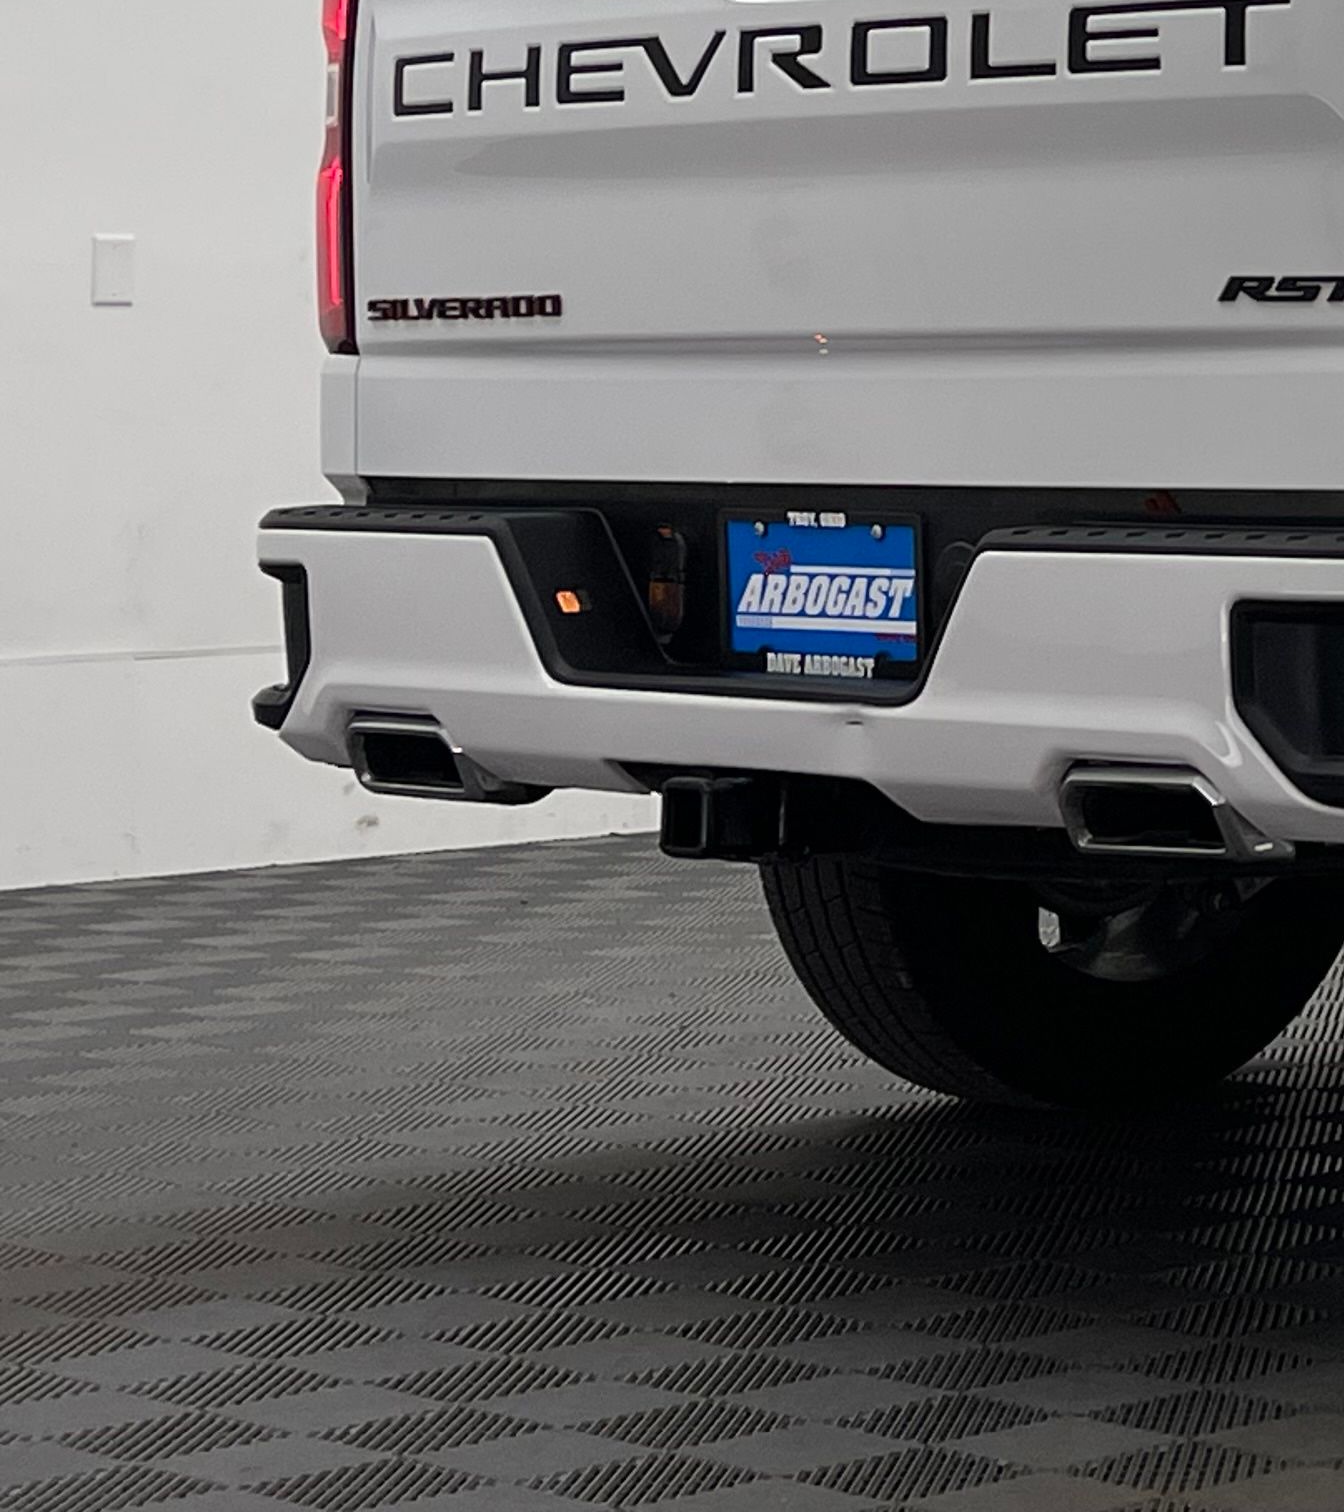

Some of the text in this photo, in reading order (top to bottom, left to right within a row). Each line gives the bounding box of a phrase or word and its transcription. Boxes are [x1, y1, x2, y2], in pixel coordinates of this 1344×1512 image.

[367, 295, 562, 320] SILVERADO
[736, 573, 916, 618] ARBOGAST
[767, 652, 875, 678] DAVE ARBOGAST
